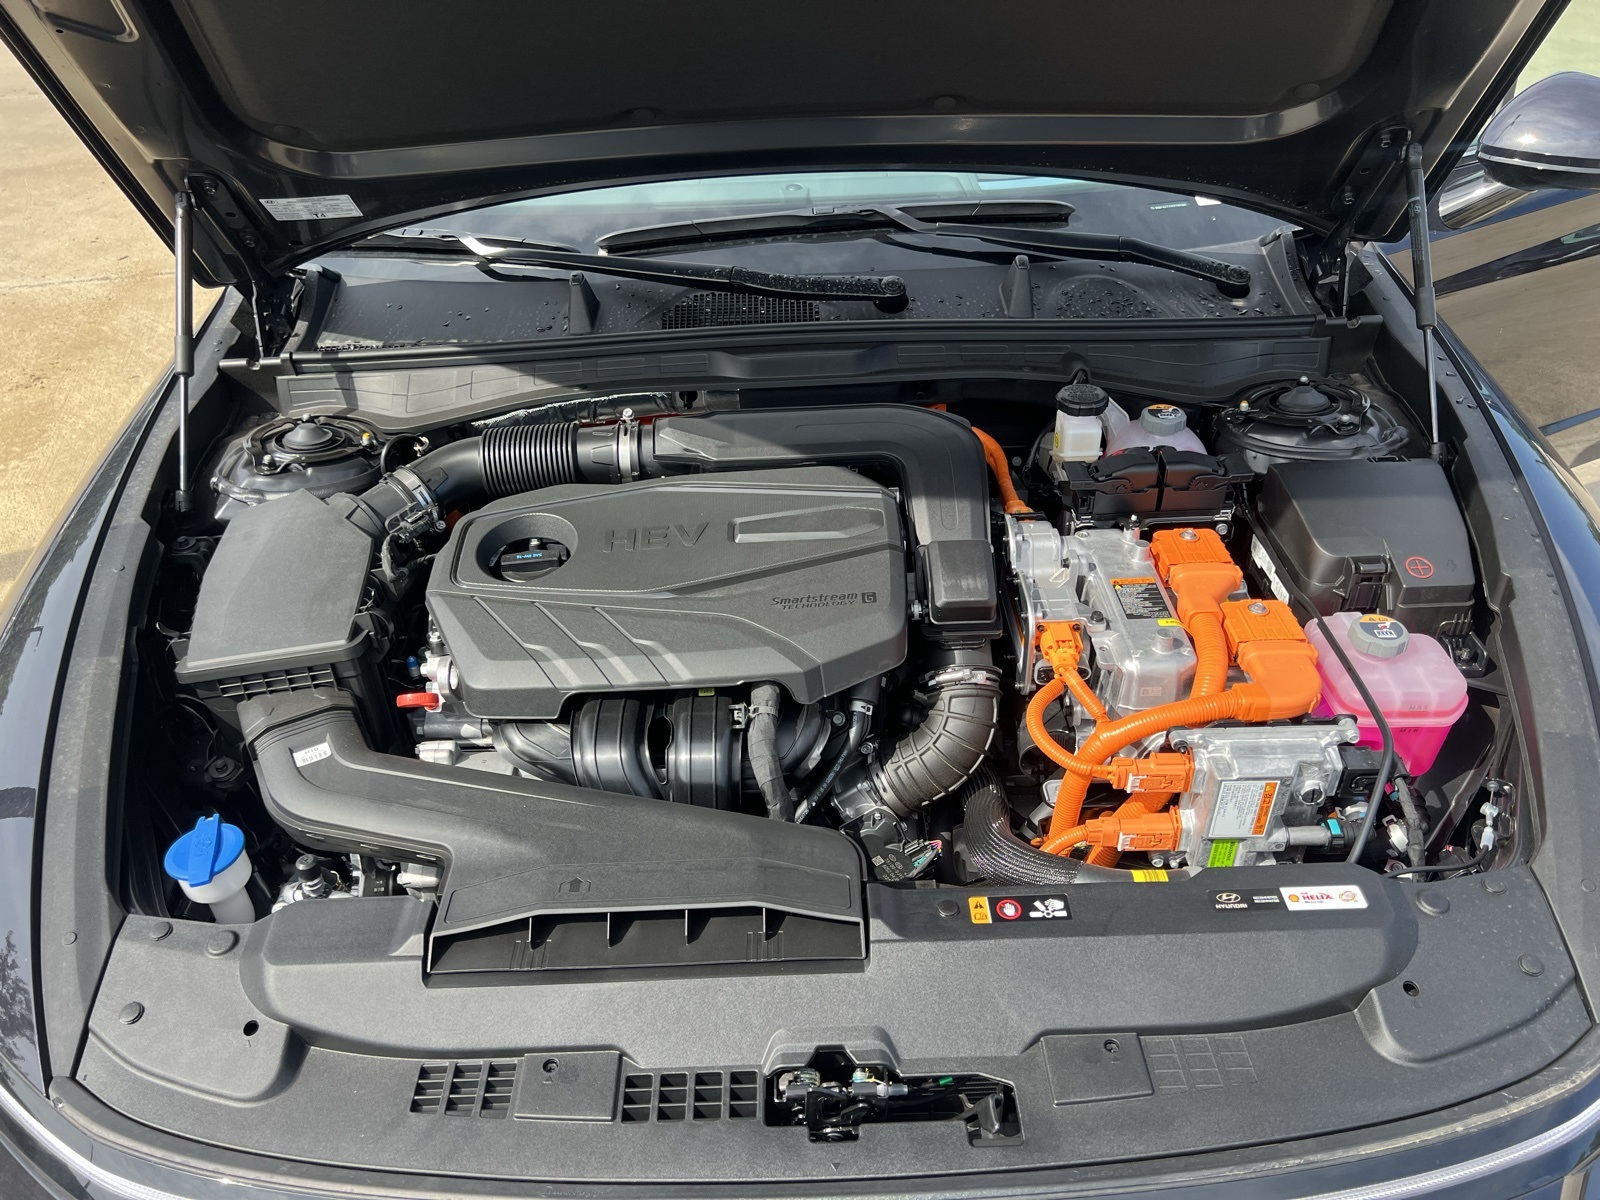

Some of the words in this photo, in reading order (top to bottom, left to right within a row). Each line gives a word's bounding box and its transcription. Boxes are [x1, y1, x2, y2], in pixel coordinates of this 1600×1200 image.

[603, 521, 709, 552] HEV
[771, 593, 858, 605] Smartstream
[782, 600, 855, 610] TECHNOLOGY
[1302, 893, 1333, 901] HELIX
